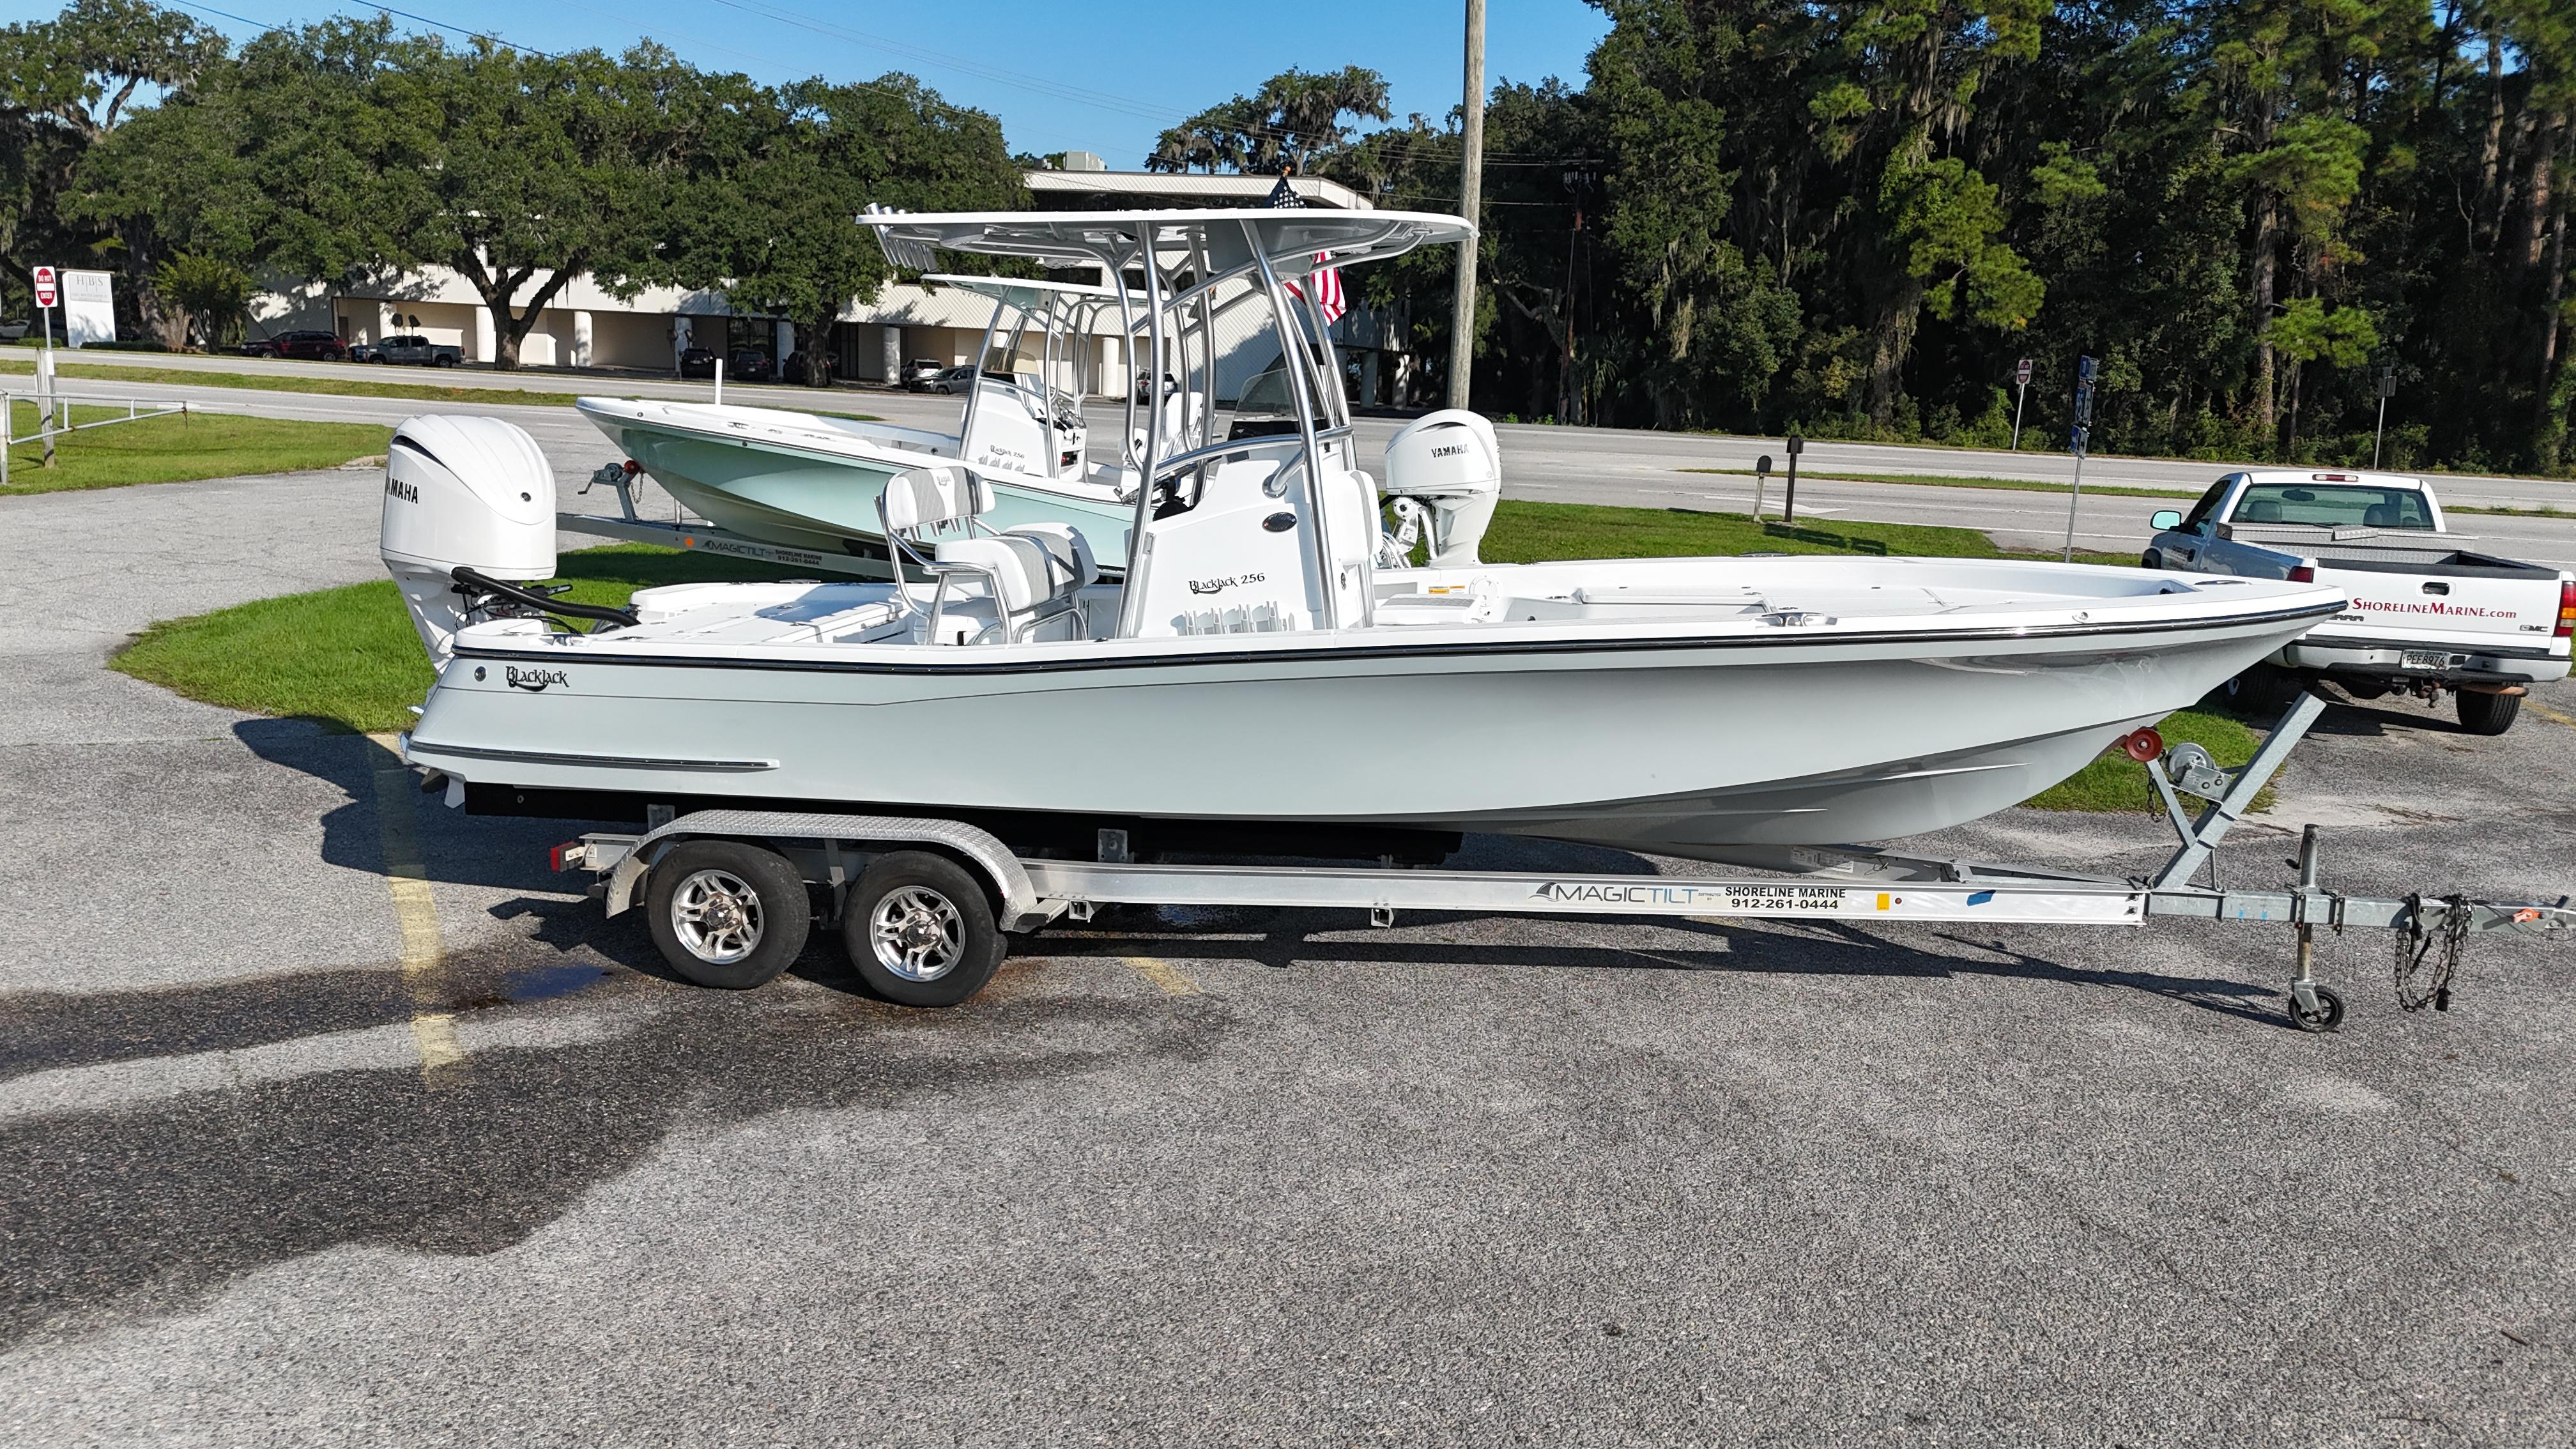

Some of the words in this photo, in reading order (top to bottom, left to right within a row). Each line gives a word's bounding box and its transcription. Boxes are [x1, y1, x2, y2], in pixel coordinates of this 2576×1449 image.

[1431, 444, 1469, 458] YAMAHA
[1241, 572, 1265, 584] 256
[2407, 654, 2444, 666] PEF8976
[1556, 885, 1699, 903] MAGICTILT
[1725, 887, 1794, 898] SHORELINE
[1798, 888, 1846, 898] MARINE
[1731, 898, 1839, 909] 912-261-0444
